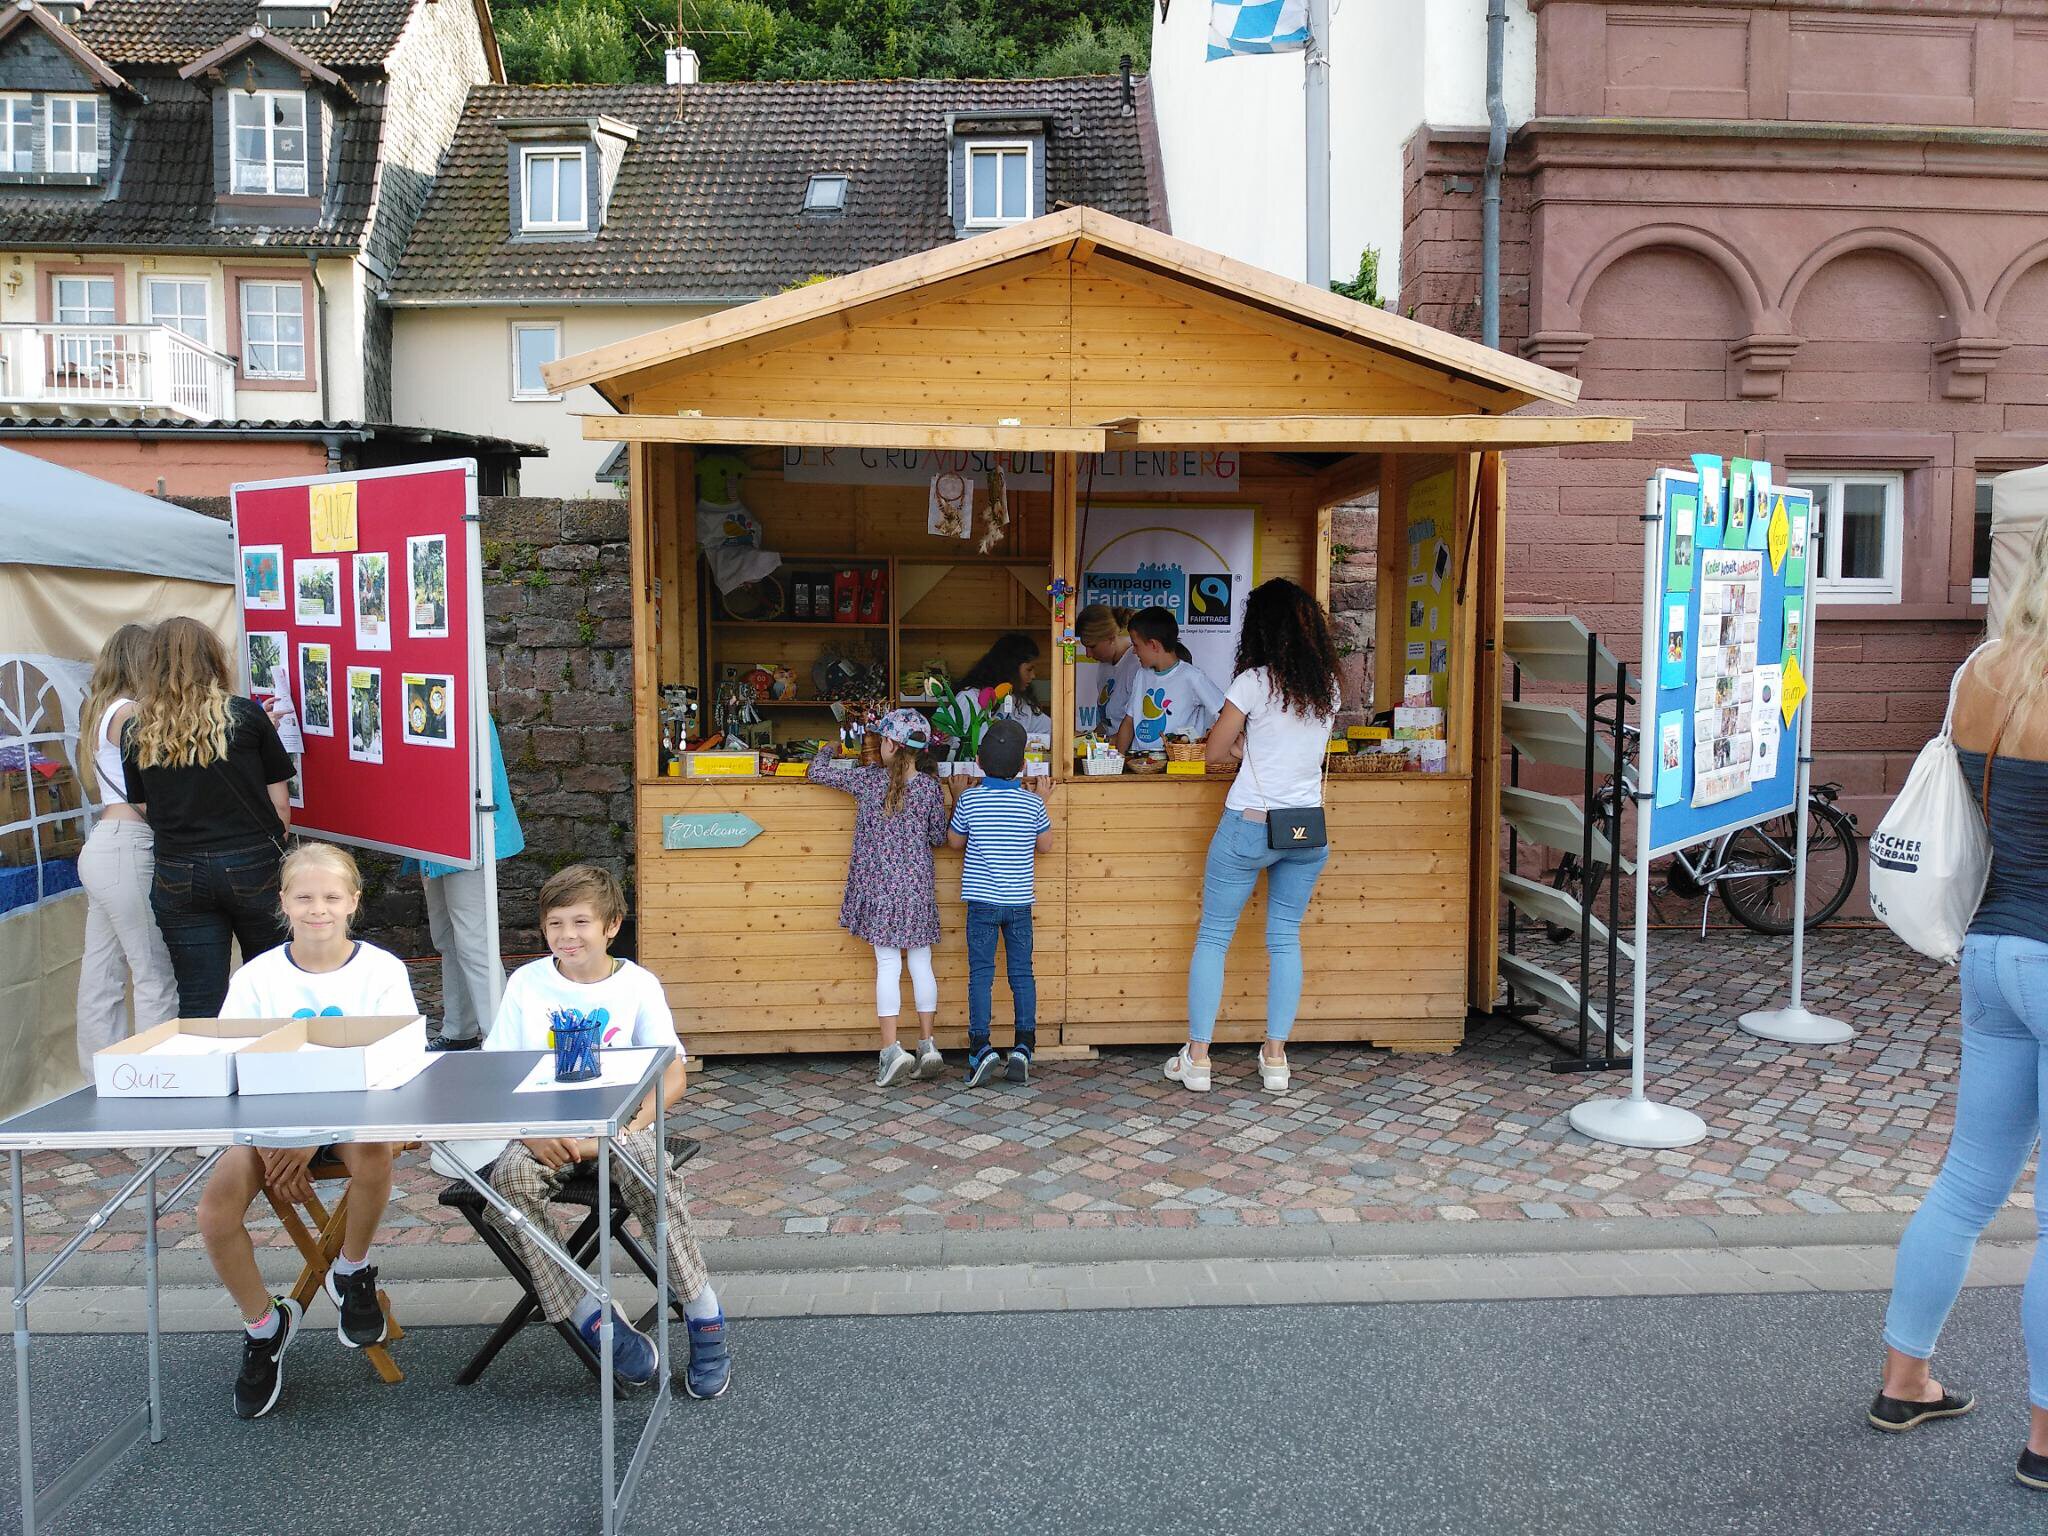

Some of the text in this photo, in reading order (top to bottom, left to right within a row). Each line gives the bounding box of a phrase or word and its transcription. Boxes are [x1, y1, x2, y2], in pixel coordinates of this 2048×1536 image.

[784, 446, 836, 466] DER
[1087, 575, 1172, 592] Kampagne
[1086, 590, 1181, 608] Fairtrade
[1190, 615, 1229, 623] FAIRTRADE
[682, 822, 748, 839] Welcome
[112, 1063, 180, 1091] Quiz
